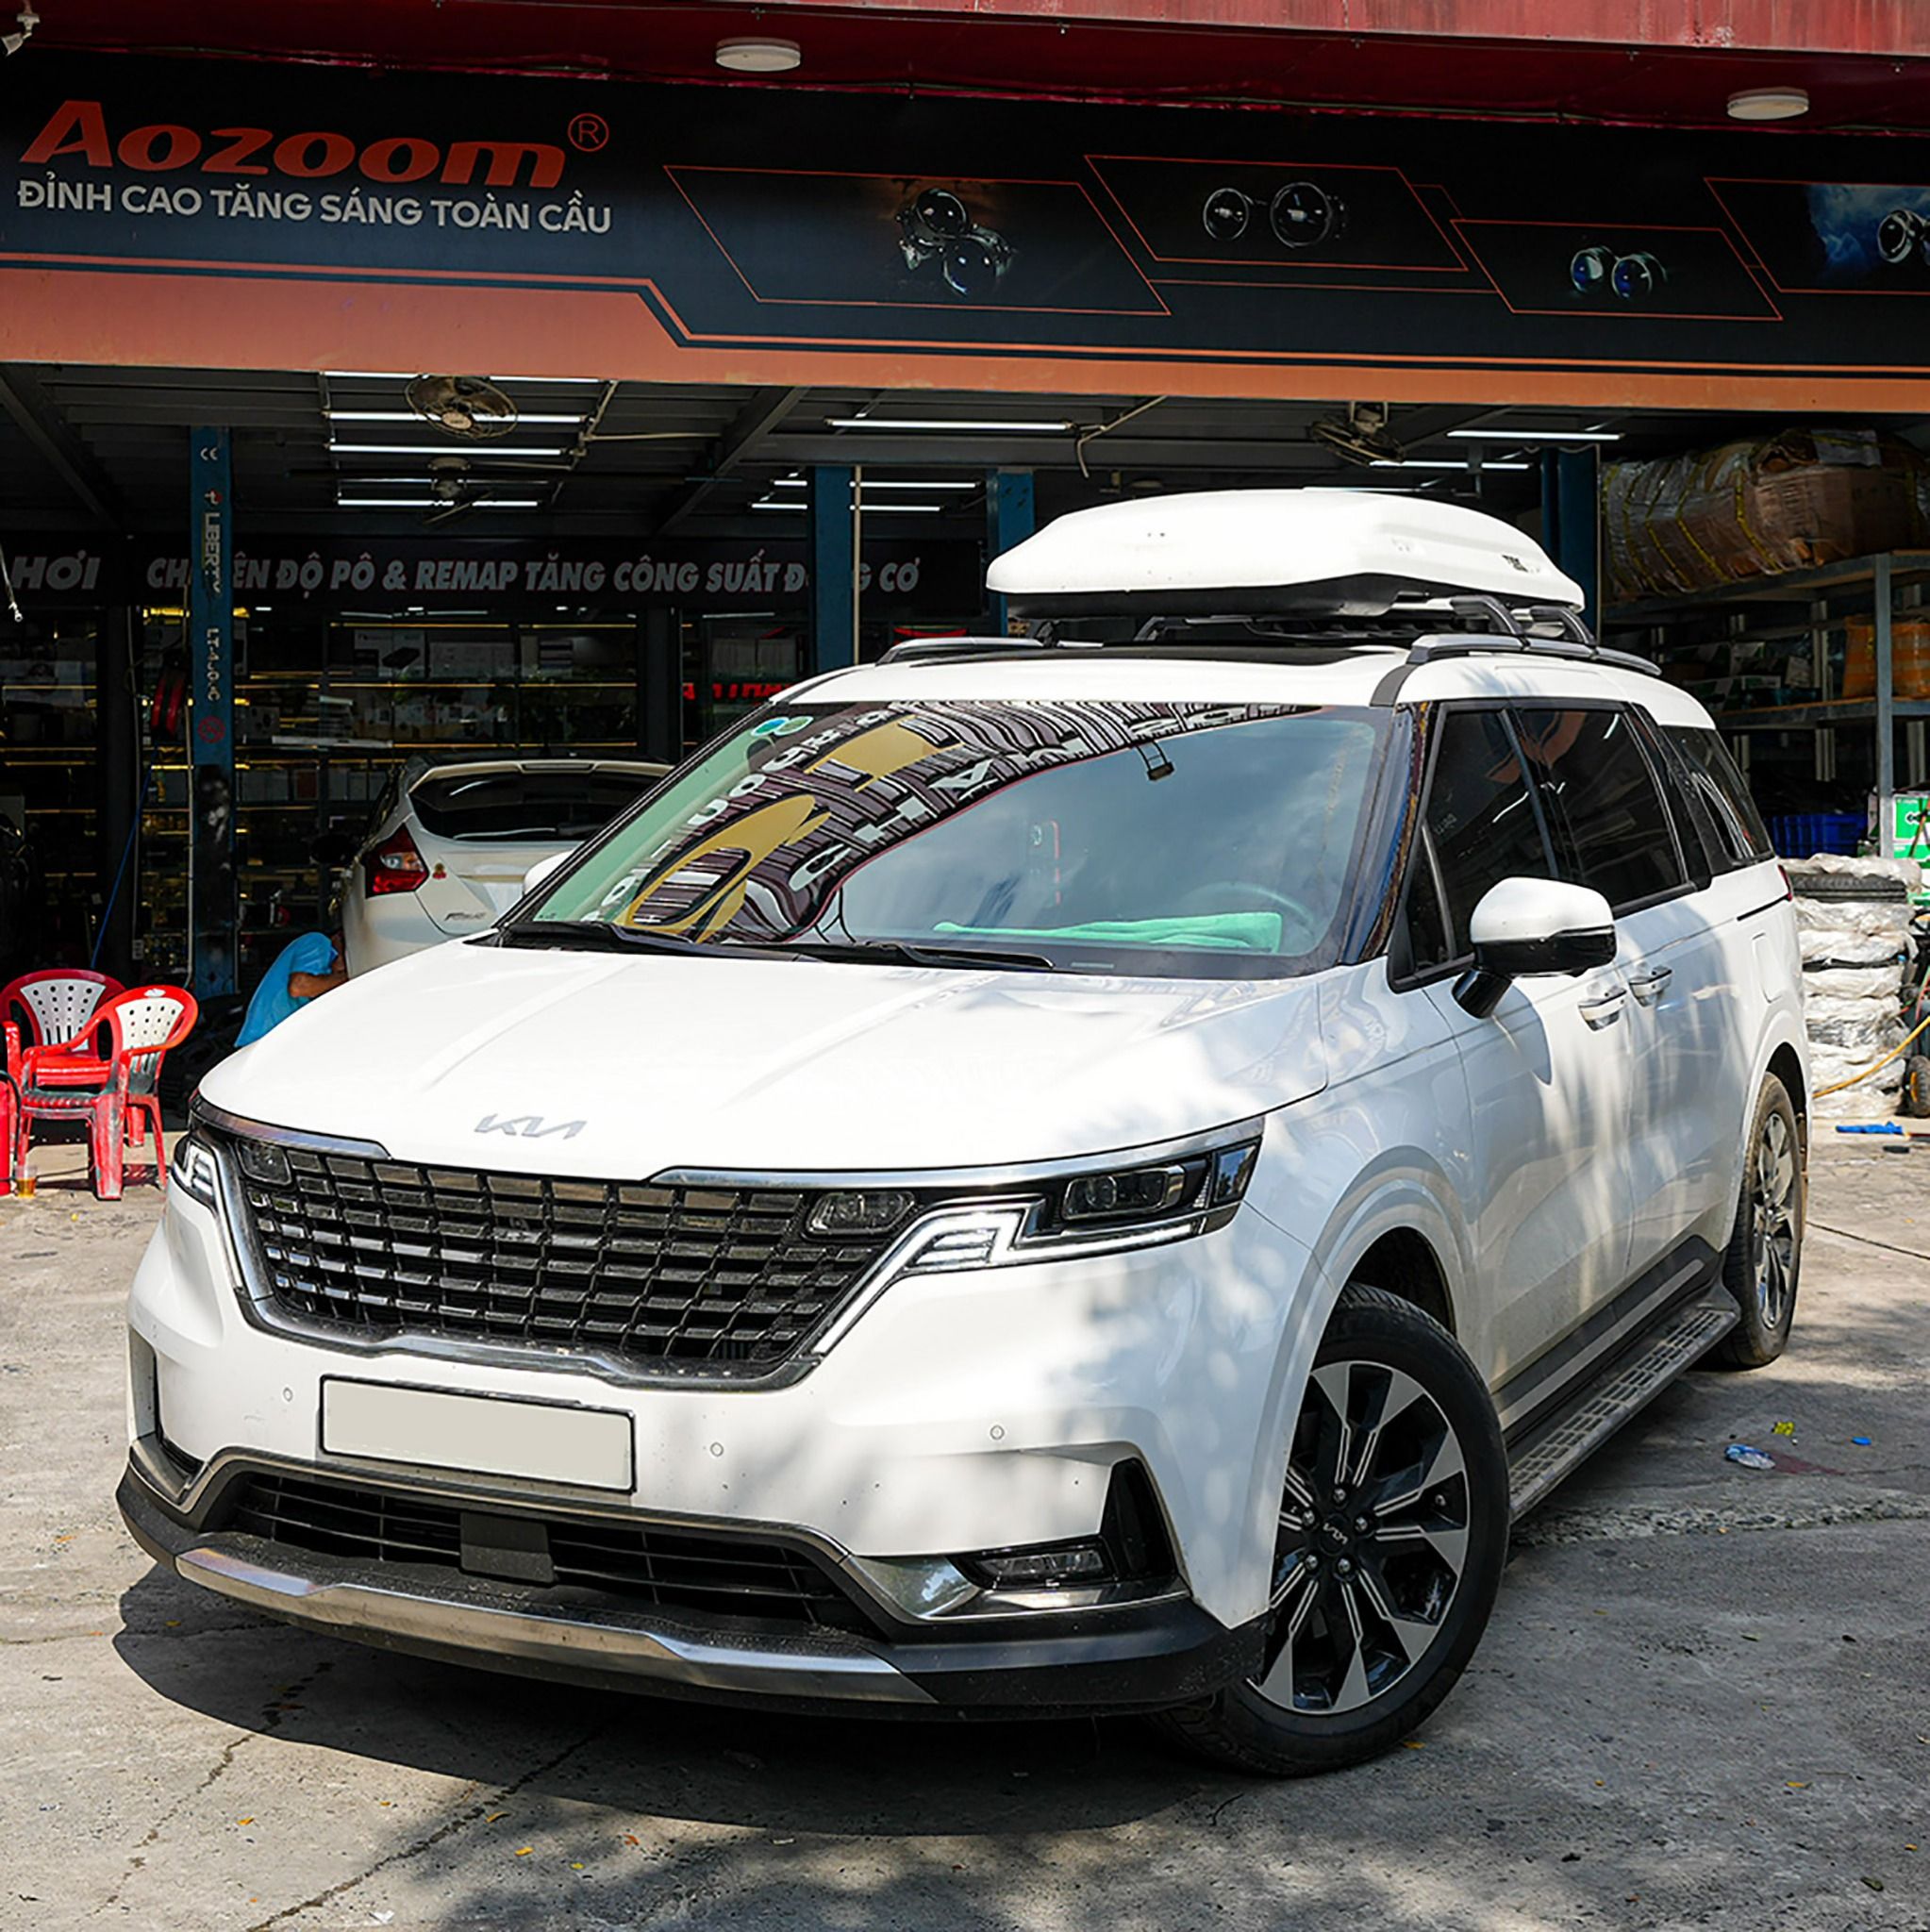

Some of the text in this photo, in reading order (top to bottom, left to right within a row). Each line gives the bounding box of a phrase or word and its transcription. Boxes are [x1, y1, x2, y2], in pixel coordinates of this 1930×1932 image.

[19, 98, 566, 189] Aozoom
[16, 170, 611, 234] ĐỈNH CAO TĂNG SÁNG TOÀN CẦU
[146, 551, 271, 589] CHÊN
[275, 550, 324, 600] ĐỘ
[330, 551, 375, 591] PÔ
[381, 559, 407, 591] &
[414, 560, 519, 591] REMAP
[524, 550, 606, 592] TĂNG
[613, 554, 700, 592] CÔNG
[705, 548, 781, 592] SUẤT
[878, 557, 921, 592] CƠ
